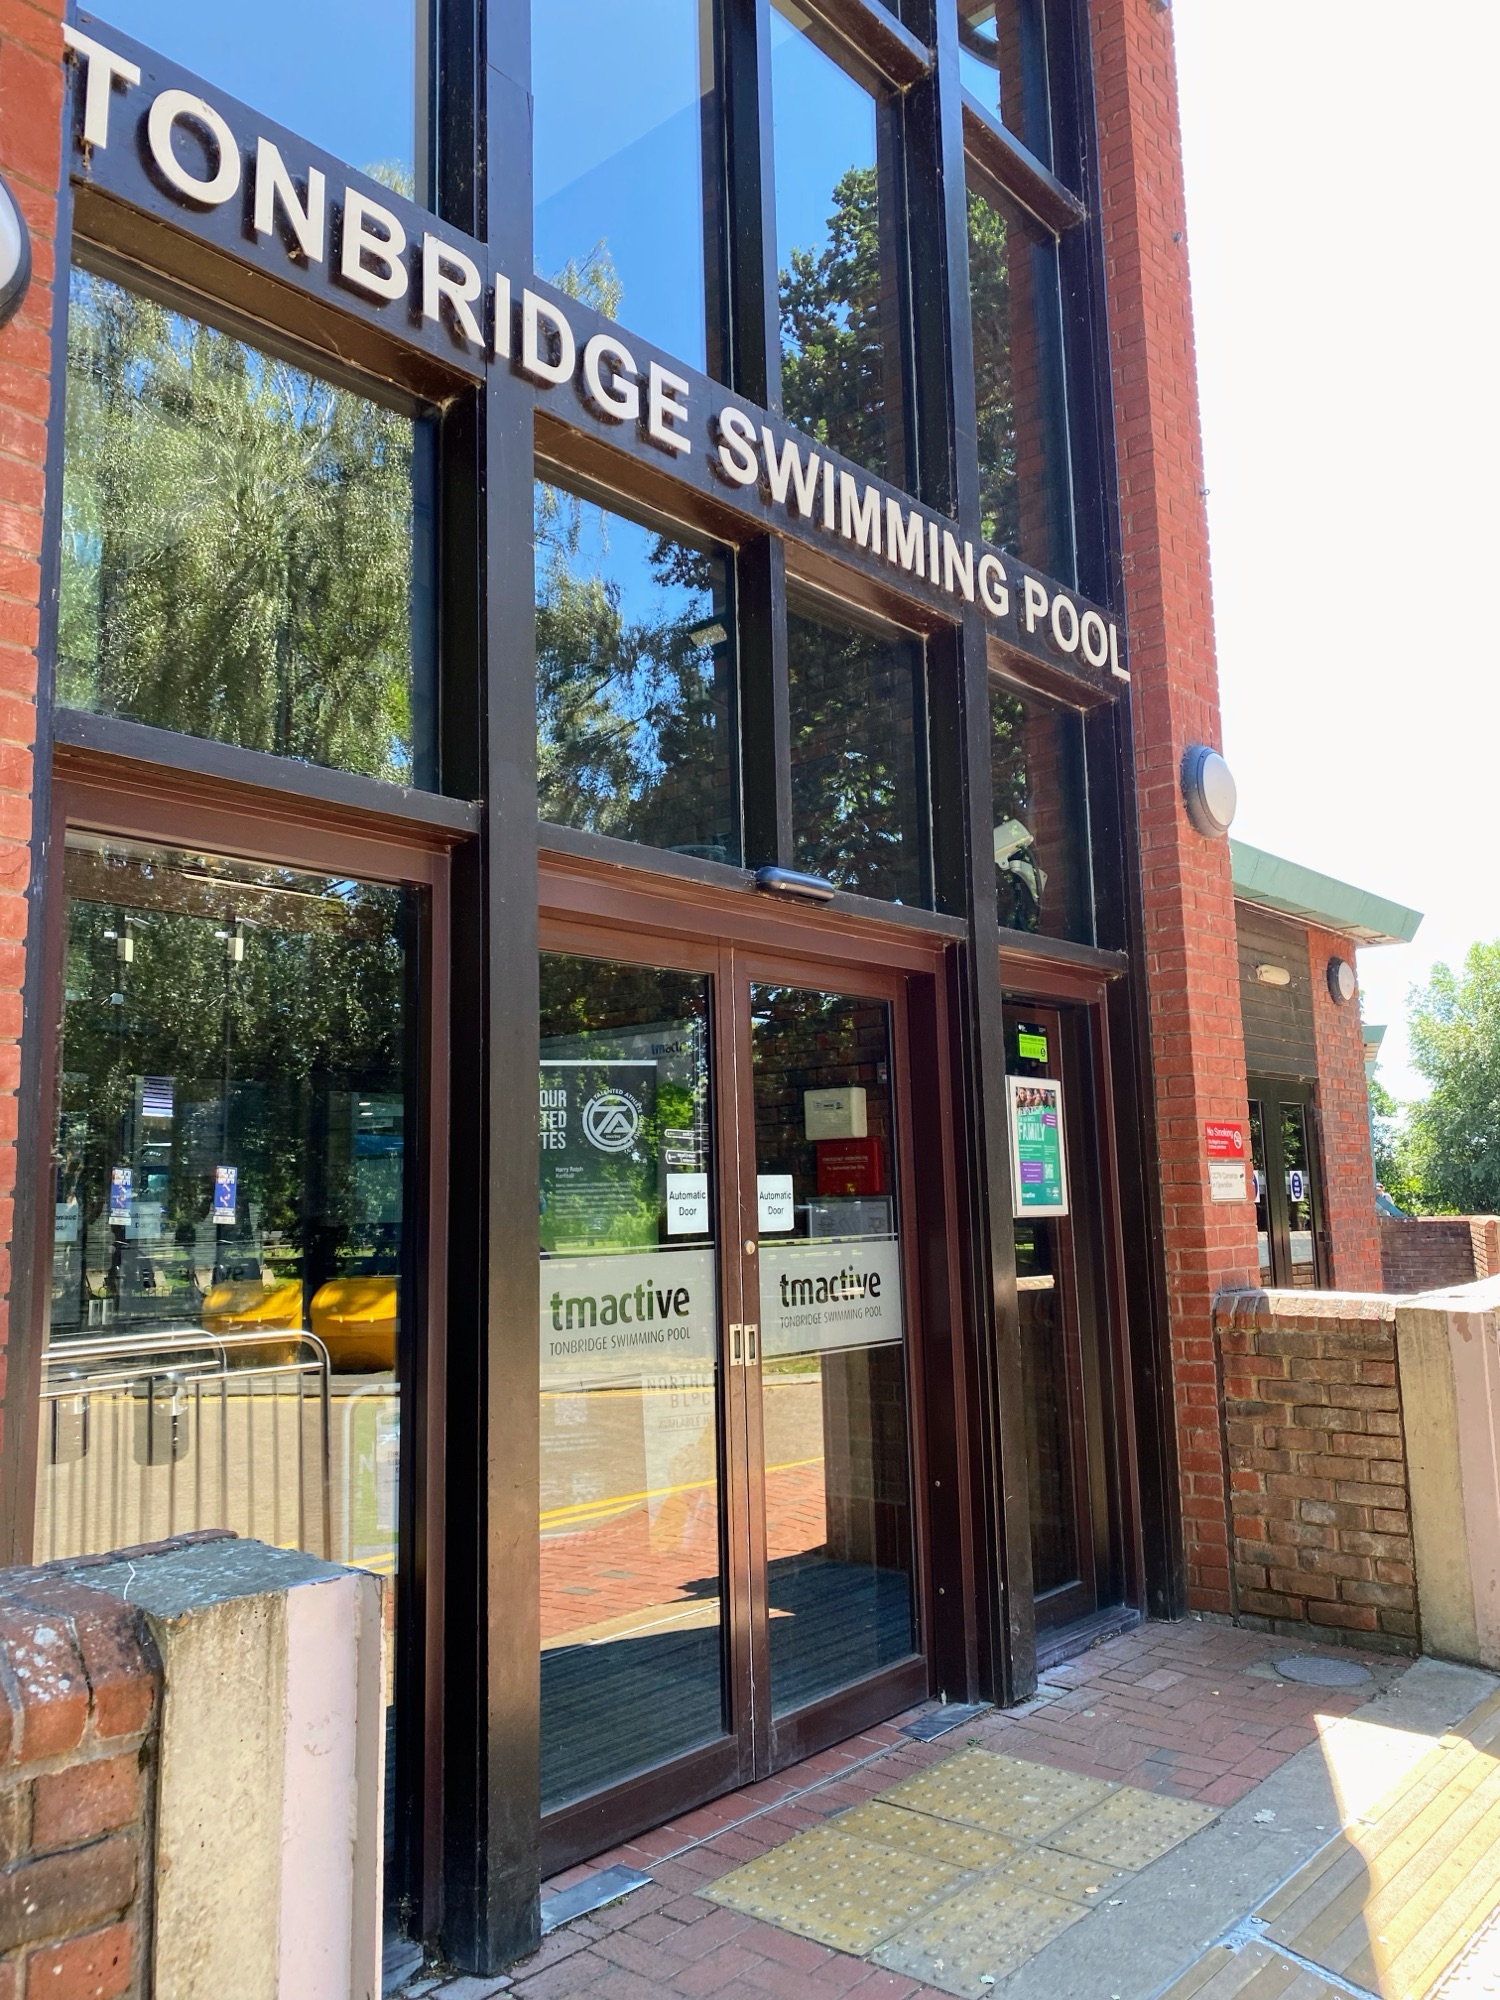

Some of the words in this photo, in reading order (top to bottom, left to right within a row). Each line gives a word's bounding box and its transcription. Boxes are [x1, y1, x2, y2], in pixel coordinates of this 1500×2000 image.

[61, 22, 691, 454] TONBRIDGE
[717, 406, 1010, 617] SWIMMING
[1023, 574, 1131, 682] POOL
[540, 1089, 567, 1108] OUR
[593, 1088, 624, 1100] TALENTED
[540, 1131, 567, 1150] TES
[1018, 1122, 1046, 1141] FAMILY
[1206, 1126, 1214, 1135] No
[1213, 1127, 1234, 1139] Smoking
[669, 1190, 706, 1200] Automatic
[759, 1190, 792, 1200] Automatic
[678, 1206, 697, 1216] Door
[767, 1206, 784, 1215] Door
[780, 1264, 881, 1308] tmactive
[550, 1279, 690, 1331] tmactive
[780, 1312, 822, 1328] TONBRIDGE
[823, 1308, 863, 1323] SWIMMING
[864, 1305, 882, 1317] POOL
[549, 1336, 607, 1356] TONBRIDGE
[611, 1329, 665, 1349] SWIMMING
[667, 1326, 691, 1341] POOL
